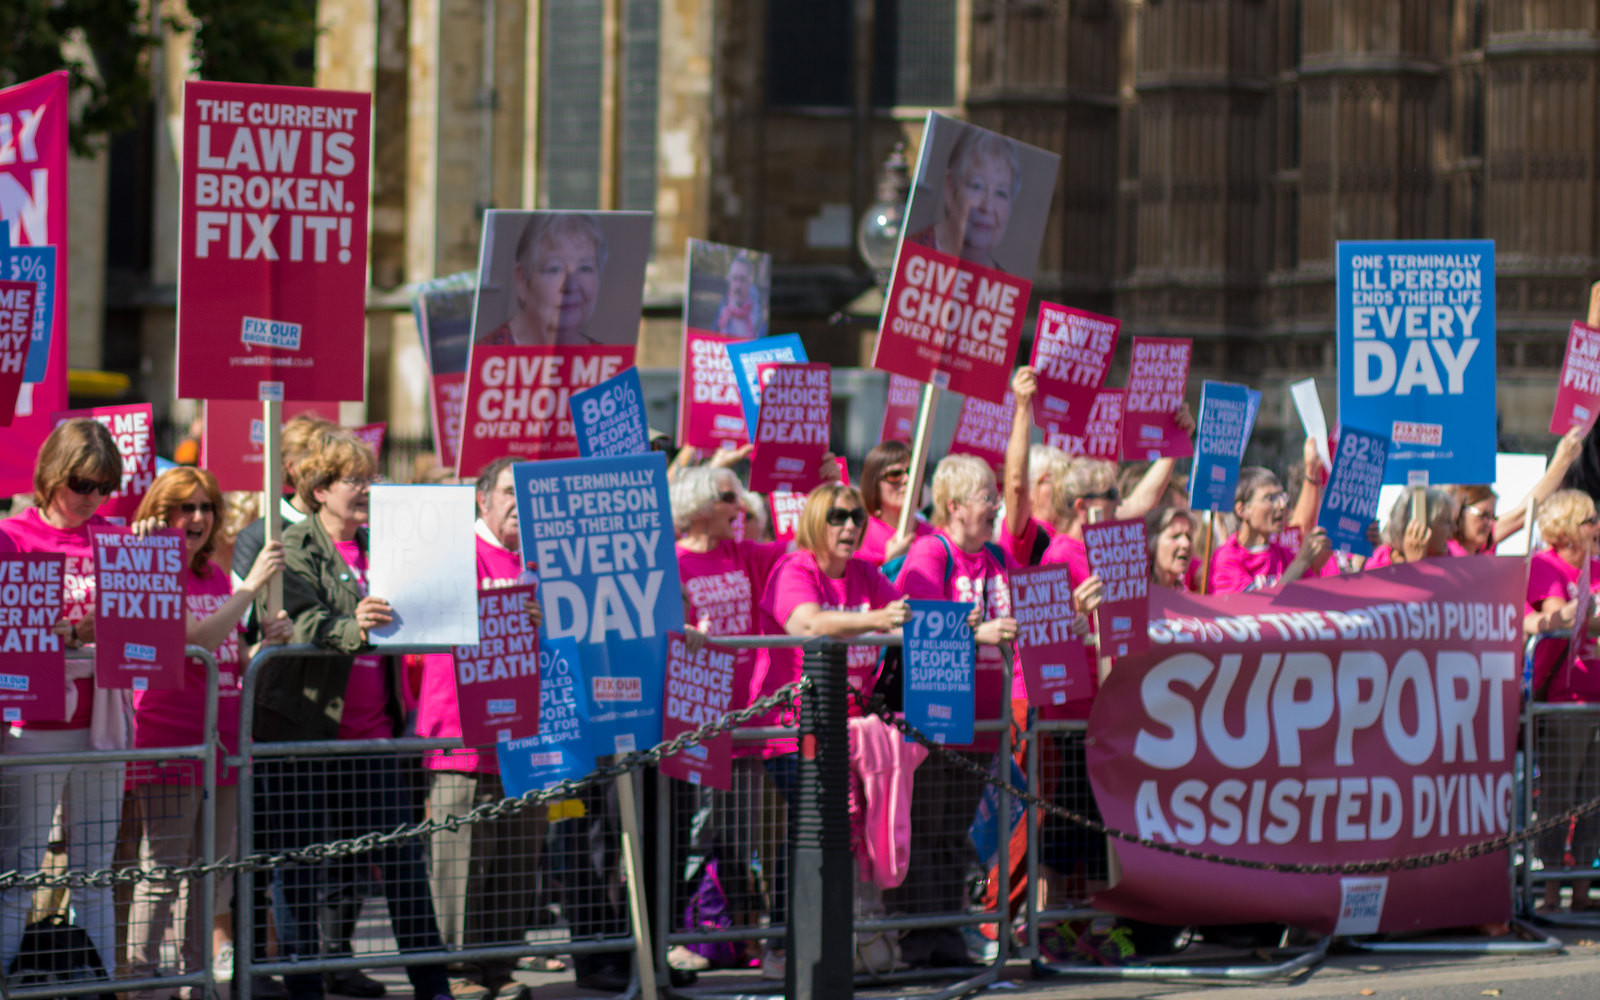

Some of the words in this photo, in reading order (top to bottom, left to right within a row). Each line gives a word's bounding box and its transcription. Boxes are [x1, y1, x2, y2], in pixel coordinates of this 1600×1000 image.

[197, 99, 245, 123] THE
[247, 102, 357, 130] CURRENT
[197, 125, 302, 173] LAW
[309, 131, 355, 176] IS
[195, 173, 355, 213] BROKEN.
[195, 211, 280, 261] FIX
[289, 215, 352, 265] IT!
[1352, 254, 1383, 270] ONE
[1387, 254, 1482, 270] TERMINALLY
[904, 255, 973, 301] GIVE
[975, 276, 1020, 317] ME
[1352, 269, 1387, 290] ILL
[1389, 269, 1482, 290] PERSON
[1352, 290, 1394, 305] ENDS
[1397, 289, 1444, 305] THEIR
[1448, 289, 1482, 305] LIFE
[244, 319, 268, 334] FIX
[270, 323, 299, 338] OUR
[897, 286, 1013, 348] CHOICE
[1044, 307, 1067, 323] THE
[1067, 313, 1116, 335] CURRENT
[1353, 304, 1482, 339] EVERY
[243, 332, 278, 345] BROKEN
[280, 337, 297, 347] LAW
[891, 316, 931, 346] OVER
[932, 329, 957, 350] MY
[957, 336, 1007, 366] DEATH
[1041, 319, 1089, 348] LAW
[1090, 330, 1112, 355] IS
[1037, 340, 1106, 369] BROKEN.
[1134, 342, 1168, 361] GIVE
[1169, 343, 1190, 361] ME
[481, 355, 564, 387] GIVE
[571, 355, 622, 386] ME
[762, 367, 804, 387] GIVE
[806, 370, 829, 387] ME
[1035, 354, 1073, 383] FIX
[1071, 364, 1103, 389] IT!
[1132, 360, 1187, 379] CHOICE
[1353, 338, 1481, 397] DAY
[763, 386, 829, 406] CHOICE
[1130, 377, 1164, 394] OVER
[1165, 379, 1185, 394] MY
[582, 380, 636, 425] 86%
[762, 404, 805, 421] OVER
[807, 406, 829, 421] MY
[966, 395, 1015, 422] CHOICE
[1101, 402, 1121, 421] IS
[1126, 392, 1184, 413] DEATH
[113, 412, 149, 435] ME
[474, 421, 521, 438] OVER
[526, 421, 553, 438] MY
[585, 423, 598, 436] OF
[599, 404, 640, 431] DISABLED
[588, 413, 643, 452] PEOPLE
[962, 411, 994, 431] OVER
[1202, 422, 1243, 439] DESERVE
[759, 422, 829, 444] DEATH
[1049, 431, 1088, 455] FIX
[1088, 435, 1118, 456] IT!
[1201, 437, 1241, 457] CHOICE
[1342, 433, 1385, 465] 82%
[528, 477, 560, 495] ONE
[563, 469, 655, 492] TERMINALLY
[1336, 466, 1382, 488] SUPPORT
[531, 494, 566, 520] ILL
[568, 487, 658, 517] PERSON
[533, 518, 575, 538] ENDS
[578, 515, 624, 534] THEIR
[627, 511, 661, 529] LIFE
[1085, 525, 1123, 548] GIVE
[1123, 522, 1146, 542] ME
[96, 533, 121, 546] THE
[123, 534, 180, 548] CURRENT
[99, 547, 154, 572] LAW
[157, 550, 182, 573] IS
[536, 529, 661, 579] EVERY
[1088, 541, 1147, 568] CHOICE
[28, 561, 61, 582] ME
[102, 572, 183, 593] BROKEN.
[687, 574, 724, 593] GIVE
[1011, 574, 1028, 587] THE
[1029, 568, 1068, 585] CURRENT
[1091, 563, 1127, 582] OVER
[1128, 560, 1148, 577] MY
[0, 583, 60, 607] OICE
[101, 591, 145, 618] FIX
[149, 593, 181, 620] IT!
[502, 592, 531, 614] ME
[1012, 583, 1051, 607] LAW
[1052, 580, 1071, 602] IS
[28, 607, 60, 627] MY
[541, 570, 665, 644] DAY
[1015, 602, 1075, 624] BROKEN.
[911, 610, 970, 640] 79%
[1018, 622, 1050, 648] FIX
[1213, 615, 1262, 643] OF
[1257, 610, 1337, 642] THE
[1325, 602, 1441, 640] BRITISH
[1443, 602, 1517, 641] PUBLIC
[456, 637, 505, 661] OVER
[508, 633, 536, 653] MY
[909, 639, 919, 650] OF
[922, 640, 971, 651] RELIGIOUS
[458, 652, 537, 686] DEATH
[707, 651, 735, 673] ME
[910, 650, 971, 668] PEOPLE
[594, 679, 613, 690] FIX
[615, 679, 640, 691] OUR
[668, 659, 734, 693] CHOICE
[910, 668, 971, 683] SUPPORT
[910, 682, 947, 692] ASSISTED
[949, 683, 971, 693] DYING
[667, 679, 706, 704] OVER
[706, 693, 732, 711] MY
[1133, 649, 1516, 770] SUPPORT
[554, 718, 580, 732] FOR
[507, 736, 539, 751] DYING
[541, 729, 581, 745] PEOPLE
[1135, 777, 1404, 846] ASSISTED
[1412, 772, 1513, 839] DYING
